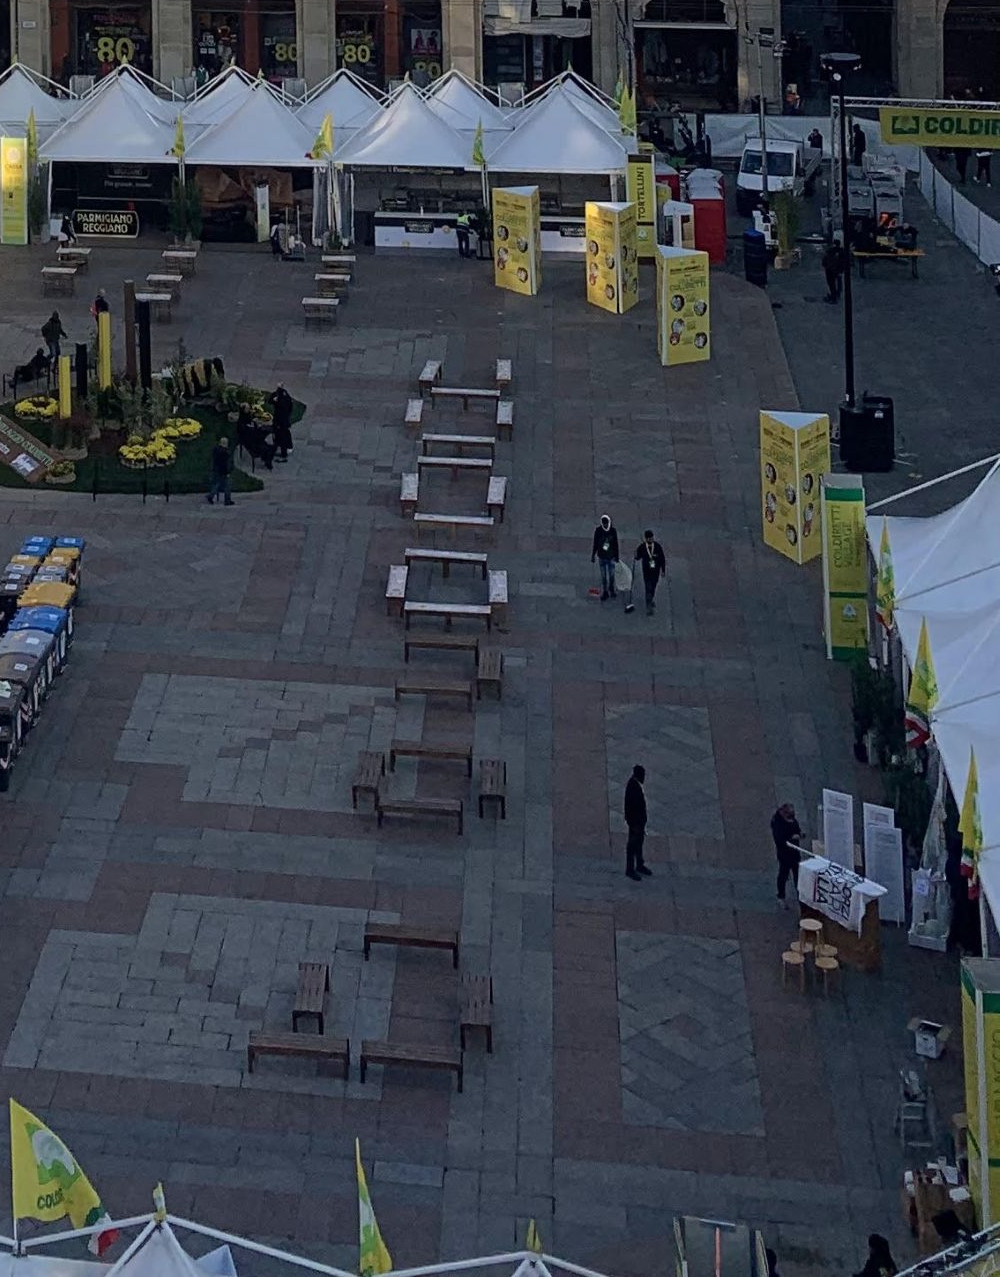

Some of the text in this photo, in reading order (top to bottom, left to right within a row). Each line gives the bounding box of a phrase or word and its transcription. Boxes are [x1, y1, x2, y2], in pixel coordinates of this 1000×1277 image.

[97, 36, 135, 62] 80
[343, 44, 371, 63] 80
[636, 166, 645, 220] TORTELLINI
[77, 213, 133, 224] PARMIGIANO
[82, 223, 129, 234] REGGIANO
[831, 505, 842, 569] COLDIRETTI
